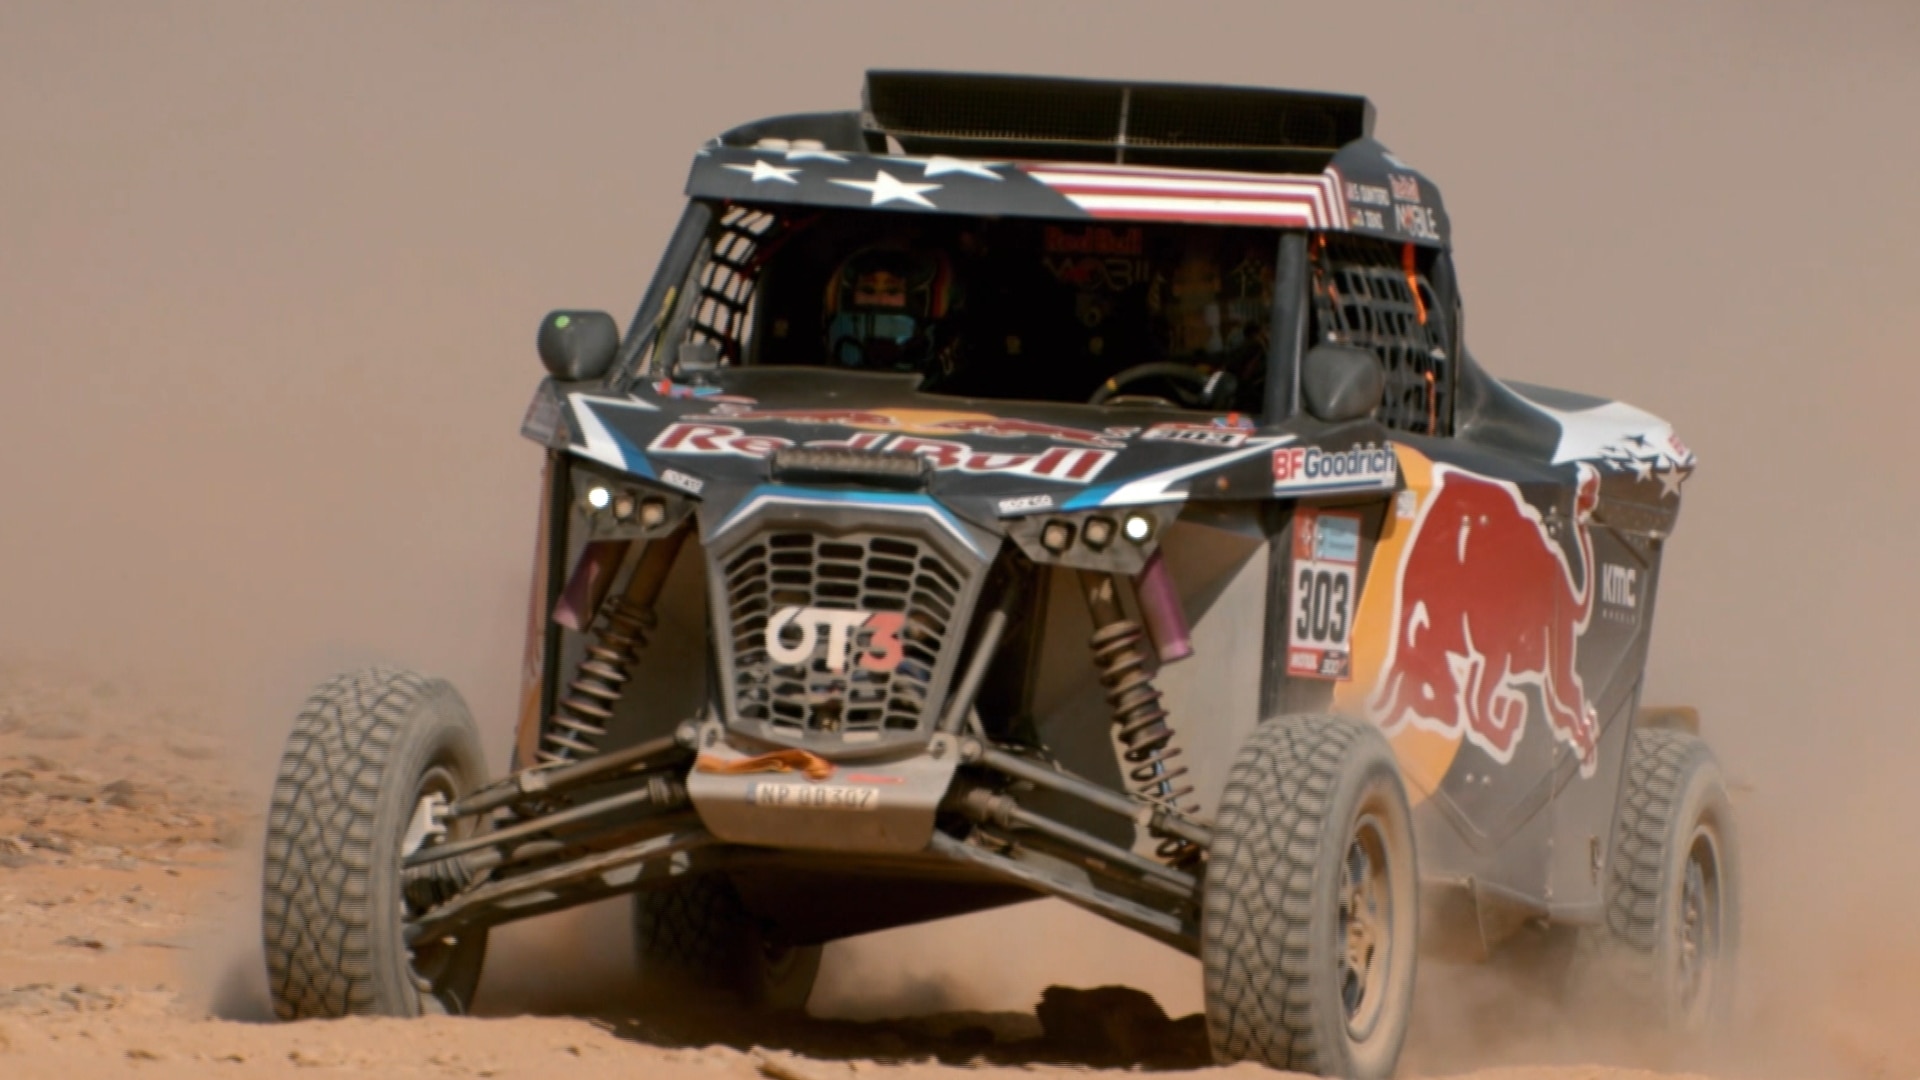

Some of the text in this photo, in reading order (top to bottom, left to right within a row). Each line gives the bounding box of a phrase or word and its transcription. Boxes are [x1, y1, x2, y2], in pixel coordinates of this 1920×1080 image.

[883, 435, 1118, 484] Bull
[1272, 440, 1395, 480] BFGoodrich
[1296, 568, 1349, 645] 303
[1602, 562, 1637, 608] KMC
